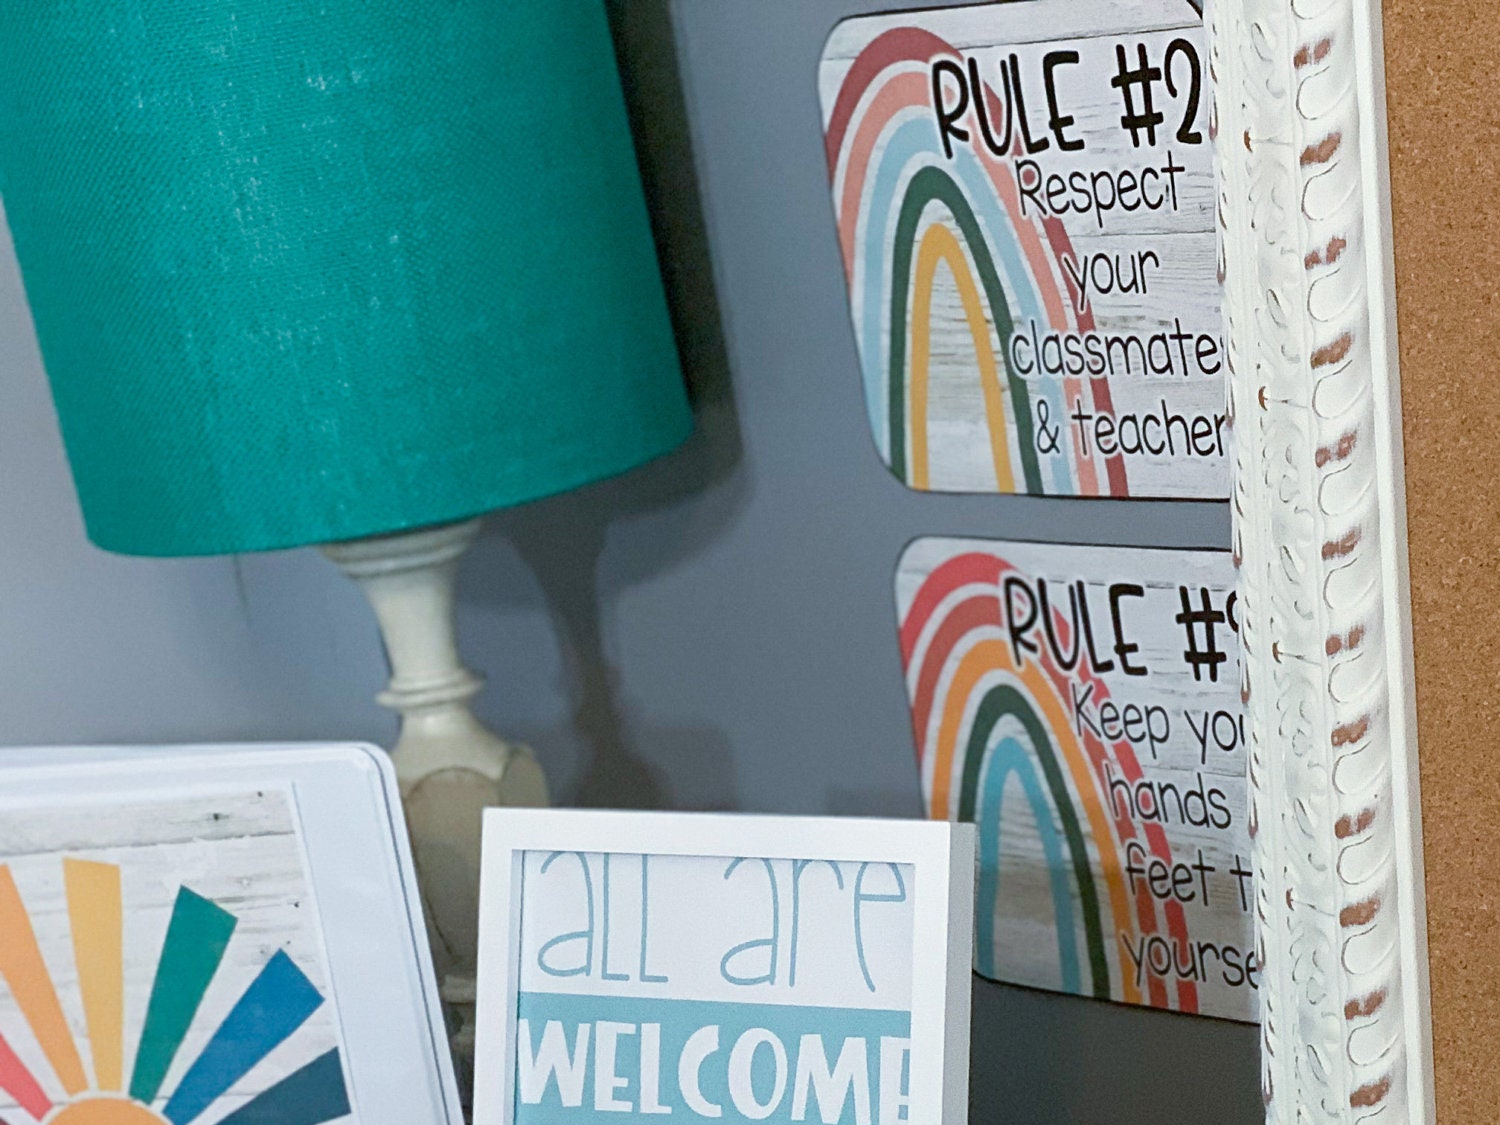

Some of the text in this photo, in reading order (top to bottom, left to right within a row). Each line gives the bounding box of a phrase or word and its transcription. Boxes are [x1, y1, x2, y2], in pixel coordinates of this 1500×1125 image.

[932, 38, 1203, 159] RULE #2
[1014, 151, 1185, 228] Respect
[1063, 251, 1159, 311] your
[1011, 319, 1224, 376] classmate
[1036, 399, 1060, 454] &
[1003, 576, 1148, 679] RULE
[1072, 683, 1170, 759] Keep
[1105, 764, 1231, 829] hands
[1126, 842, 1215, 907] feet
